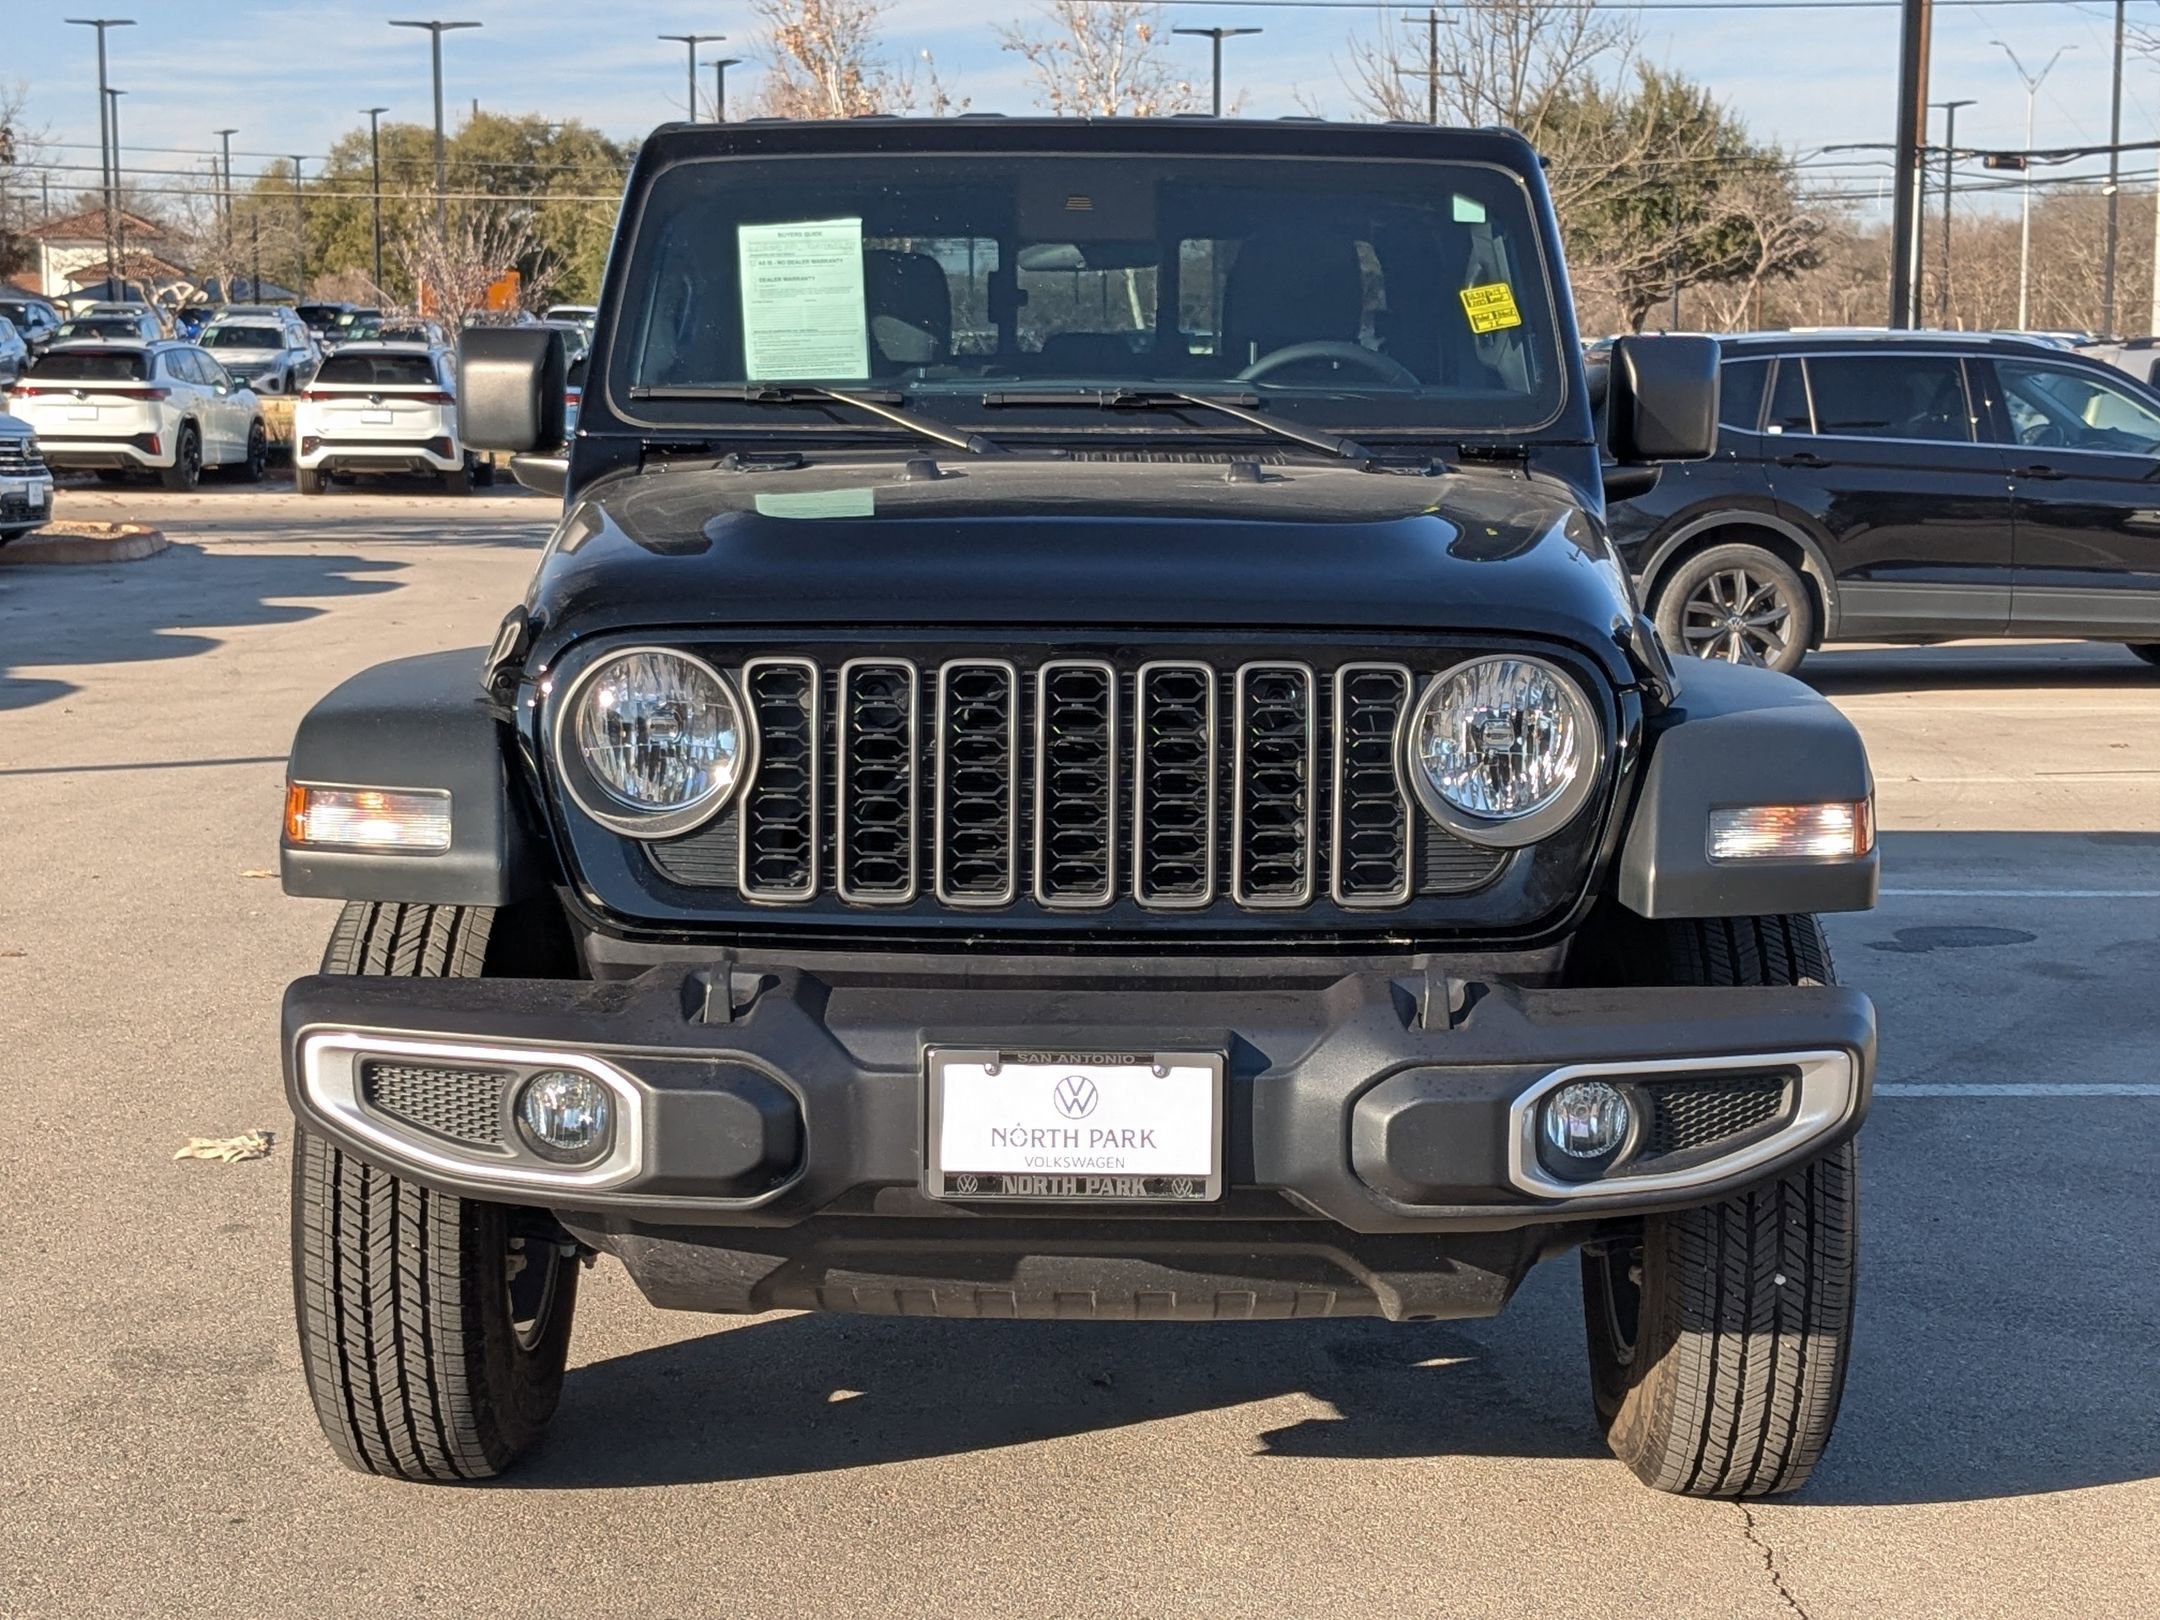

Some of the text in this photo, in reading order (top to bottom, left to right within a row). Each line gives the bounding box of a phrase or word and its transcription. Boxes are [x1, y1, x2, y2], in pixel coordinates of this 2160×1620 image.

[1017, 1053, 1136, 1065] SAN ANTONIO
[991, 1125, 1158, 1149] NORTH PARK
[1024, 1156, 1125, 1169] VOLKSWAGEN
[1001, 1175, 1148, 1197] NORTH PARK
